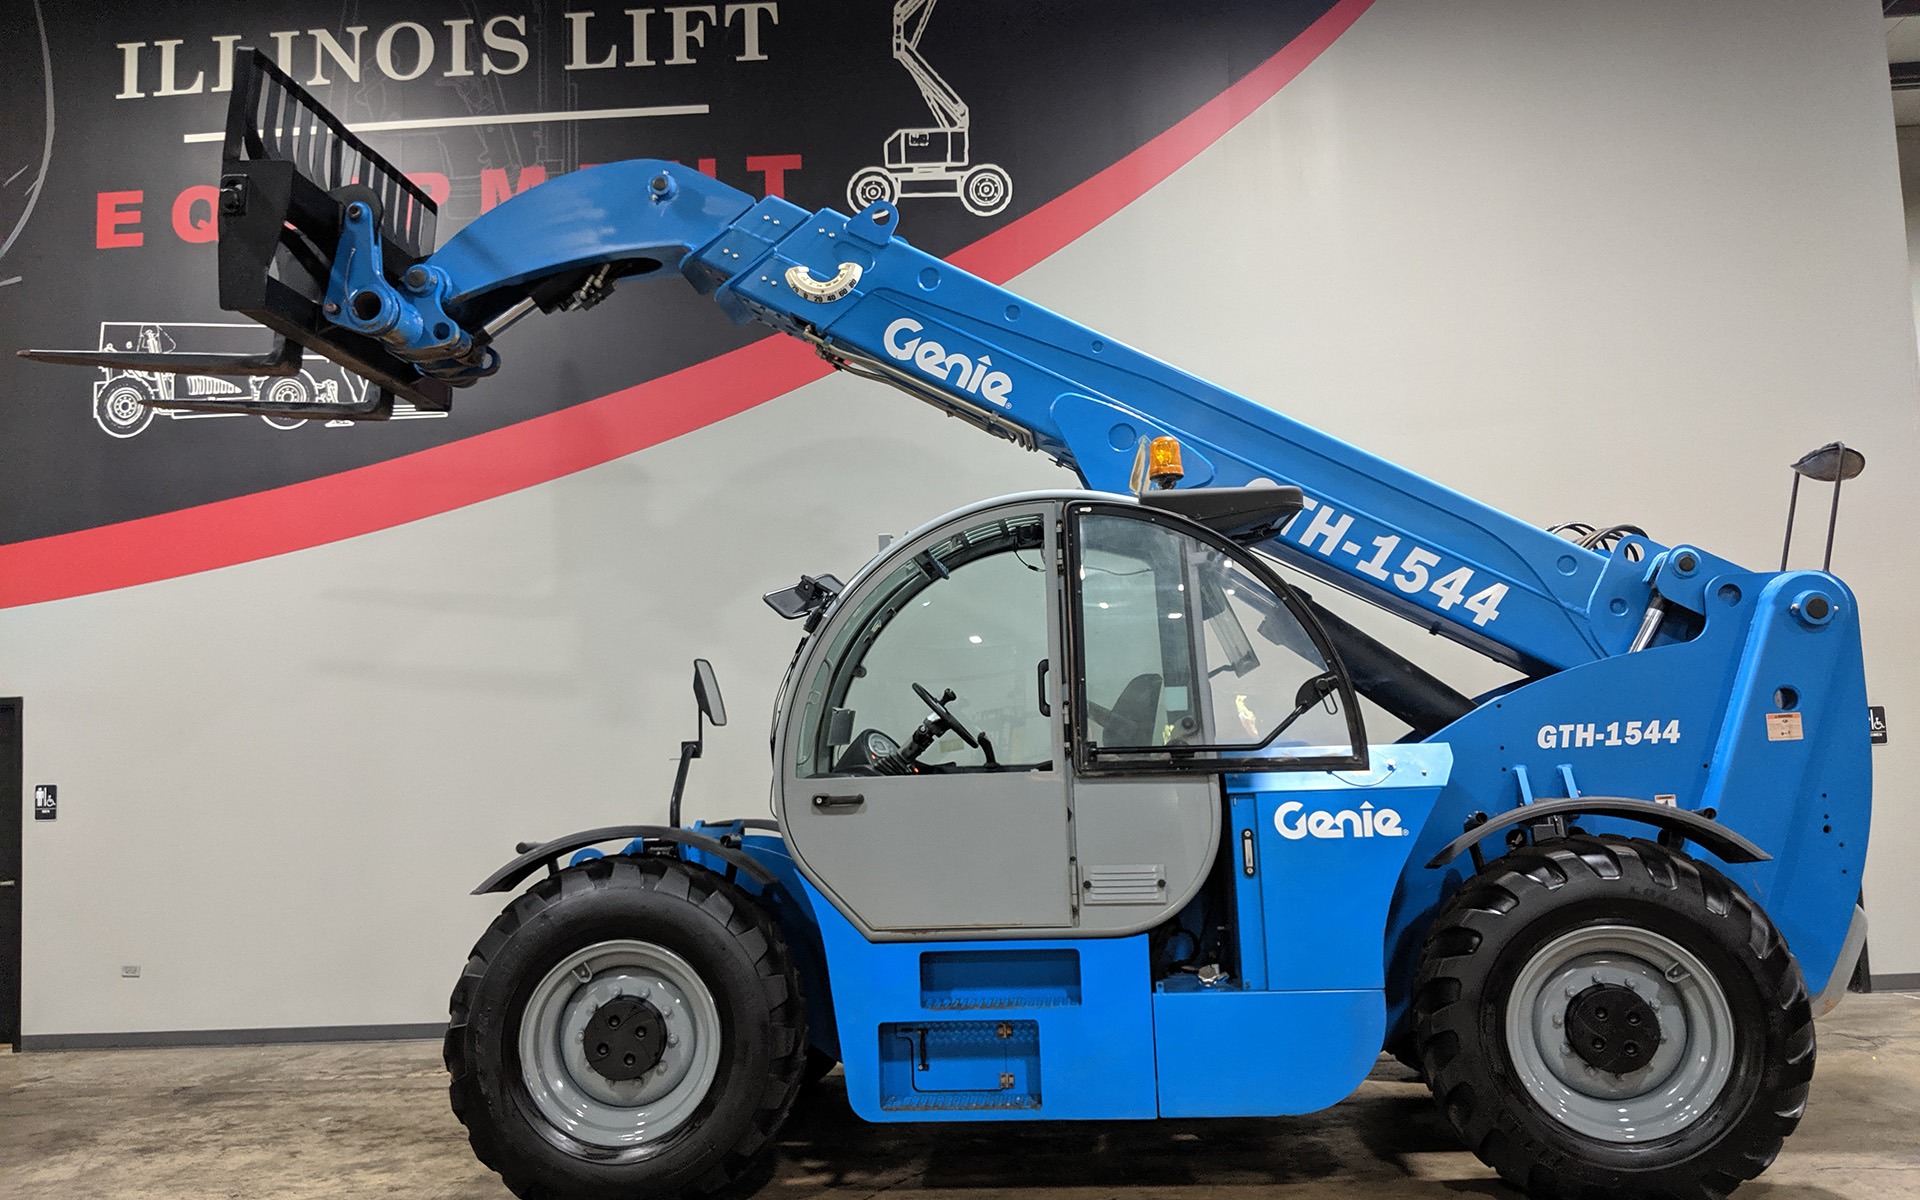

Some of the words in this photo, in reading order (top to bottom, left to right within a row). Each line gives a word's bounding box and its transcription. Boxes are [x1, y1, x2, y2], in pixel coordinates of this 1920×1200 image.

[115, 15, 530, 100] ILLINOIS
[564, 2, 779, 71] LIFT
[883, 317, 1013, 407] Genie
[1537, 719, 1681, 749] GTH-1544
[1274, 800, 1403, 840] Genie
